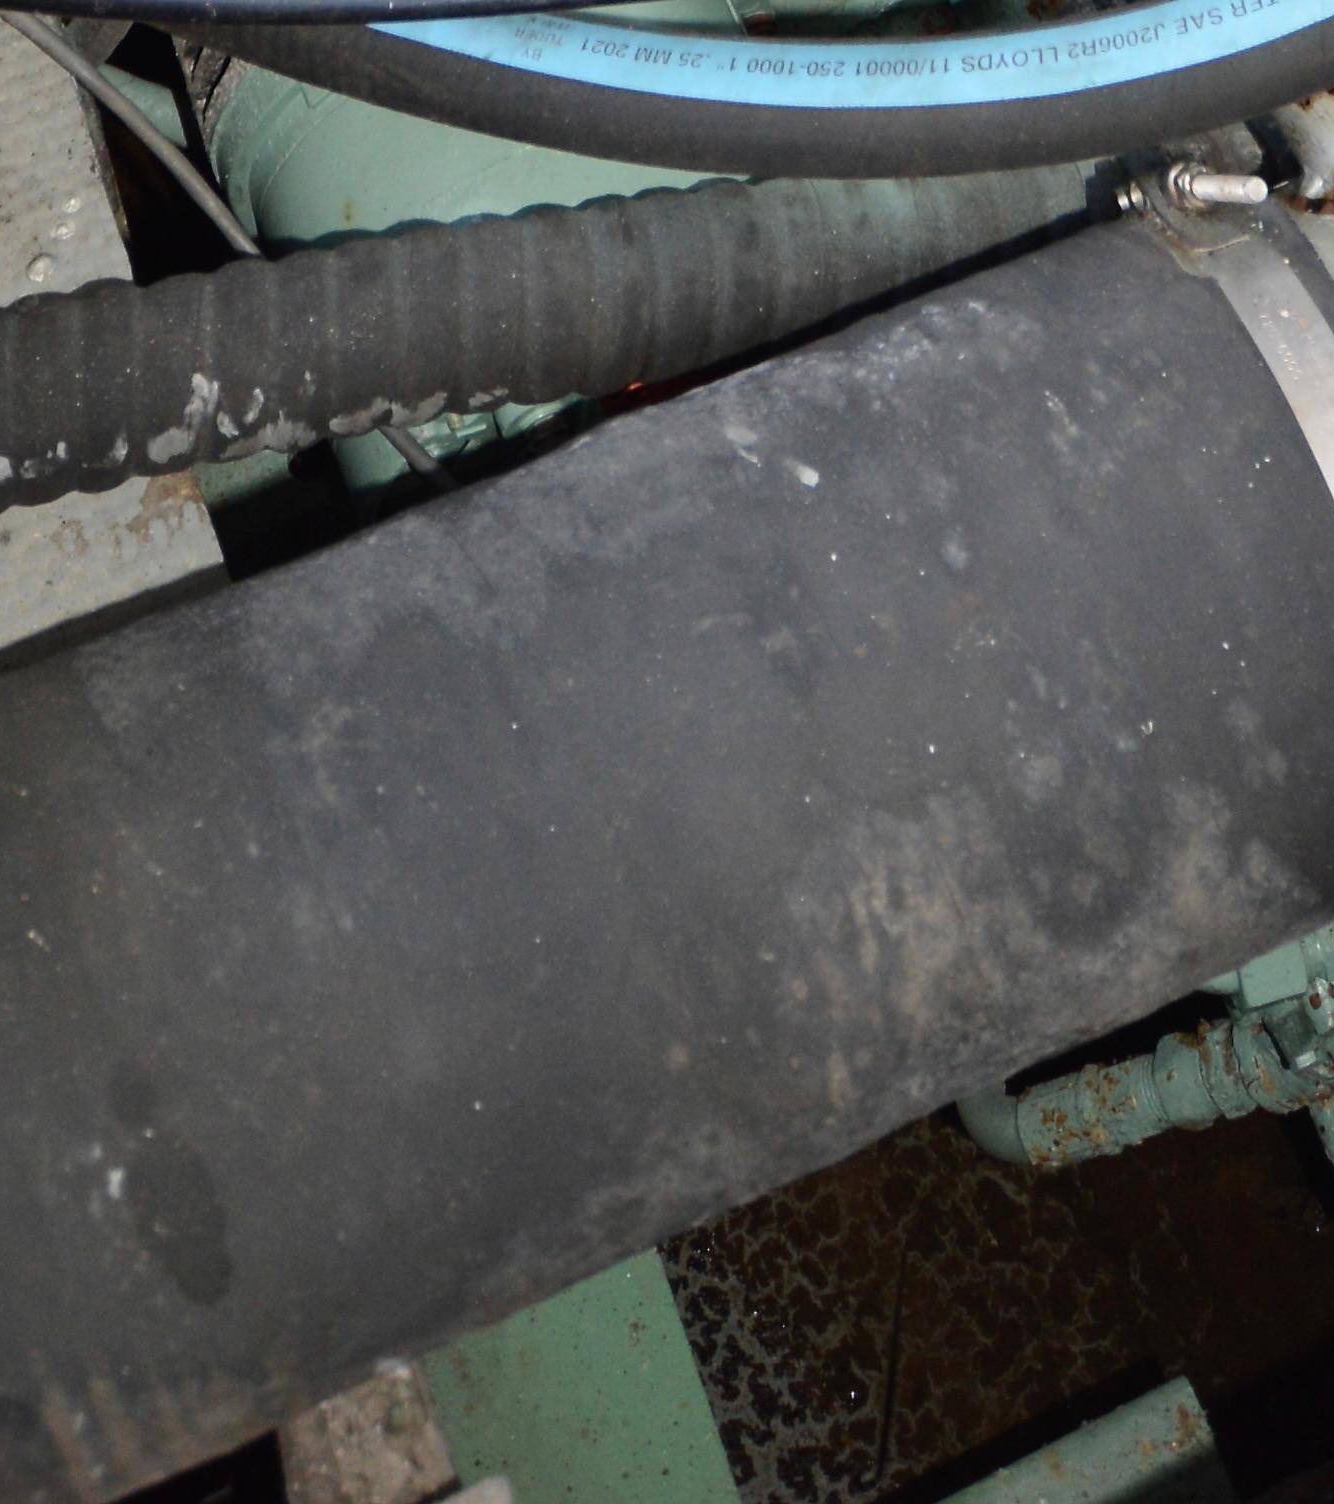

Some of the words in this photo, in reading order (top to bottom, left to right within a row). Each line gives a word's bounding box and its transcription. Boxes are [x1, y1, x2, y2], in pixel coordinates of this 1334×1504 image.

[1176, 9, 1224, 37] SAE
[580, 37, 629, 59] 2021
[1067, 23, 1166, 60] J2006R2
[523, 47, 543, 62] BY
[634, 47, 673, 65] MM
[961, 46, 1059, 74] LLOYDS
[747, 57, 845, 77] 250-1000
[855, 57, 949, 76] 11/00001
